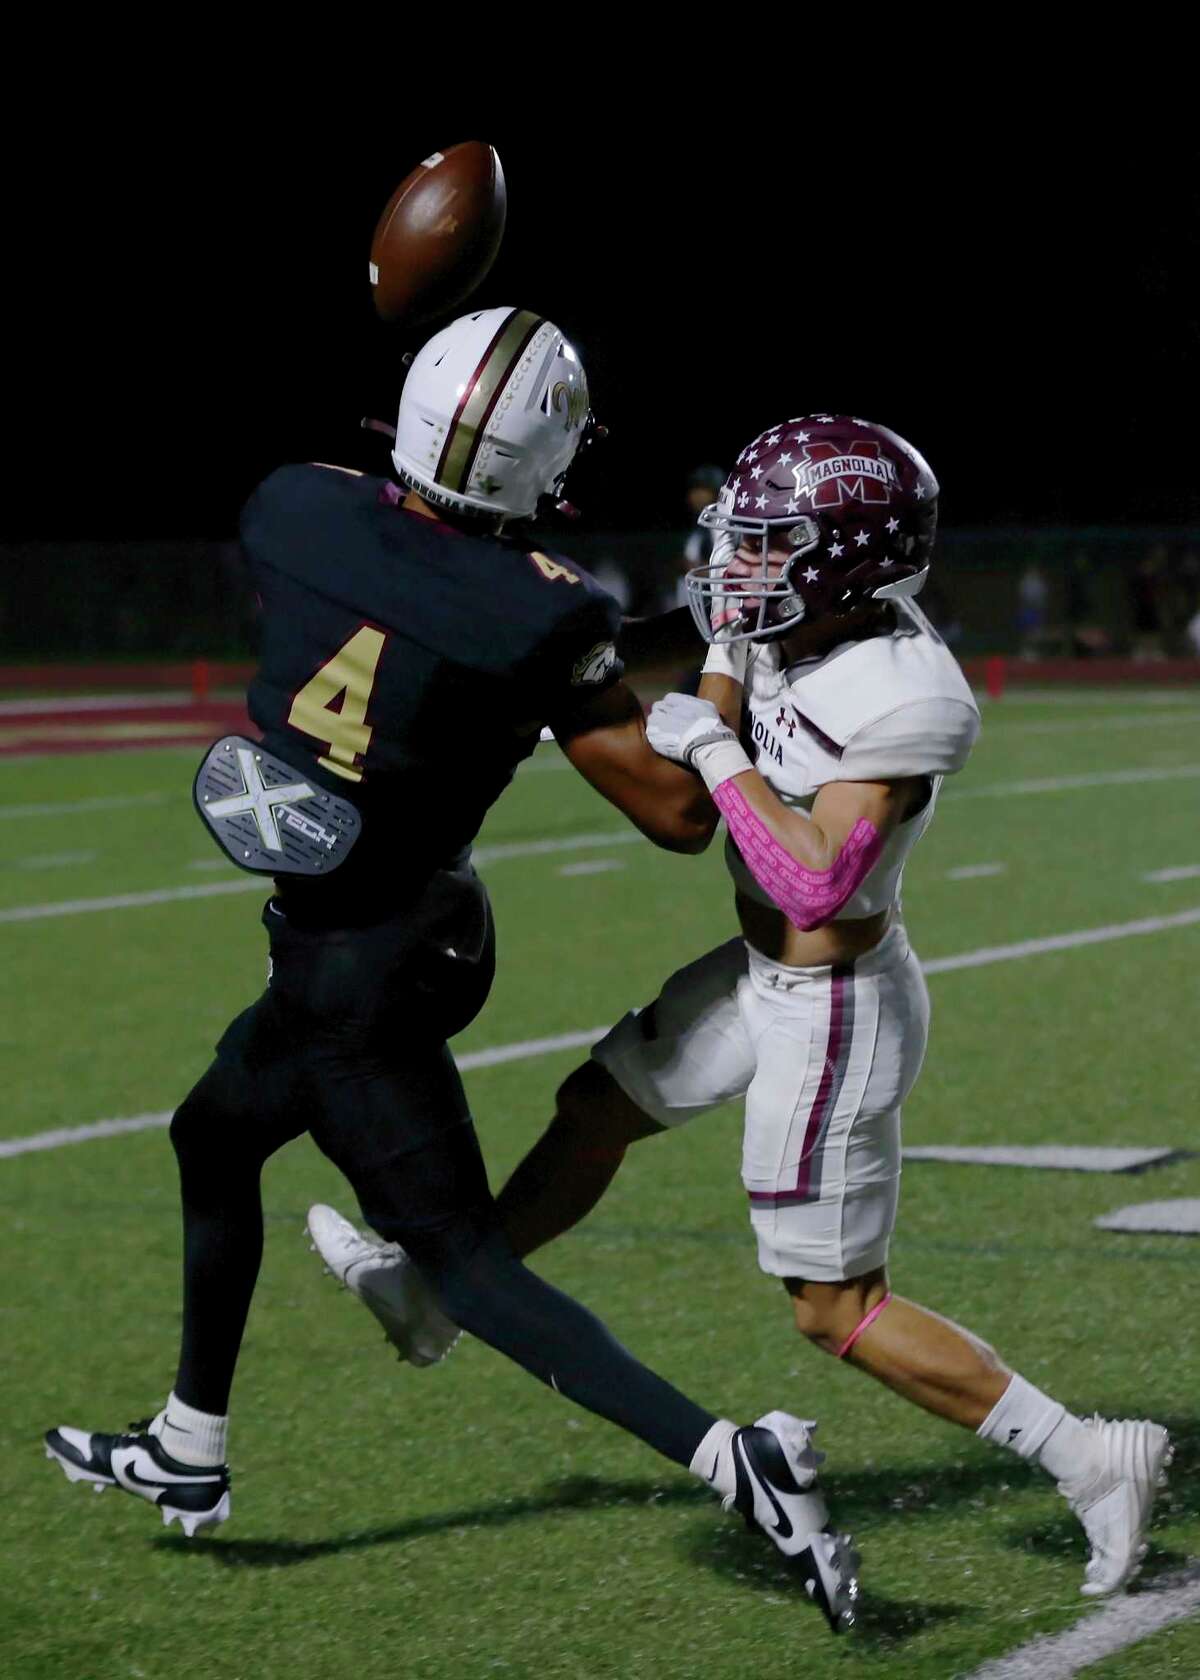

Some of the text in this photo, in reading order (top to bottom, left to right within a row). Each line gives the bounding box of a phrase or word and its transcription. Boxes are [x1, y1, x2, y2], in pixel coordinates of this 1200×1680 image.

[810, 458, 884, 482] MAGNOLIA
[528, 551, 580, 584] 4
[287, 624, 387, 783] 4
